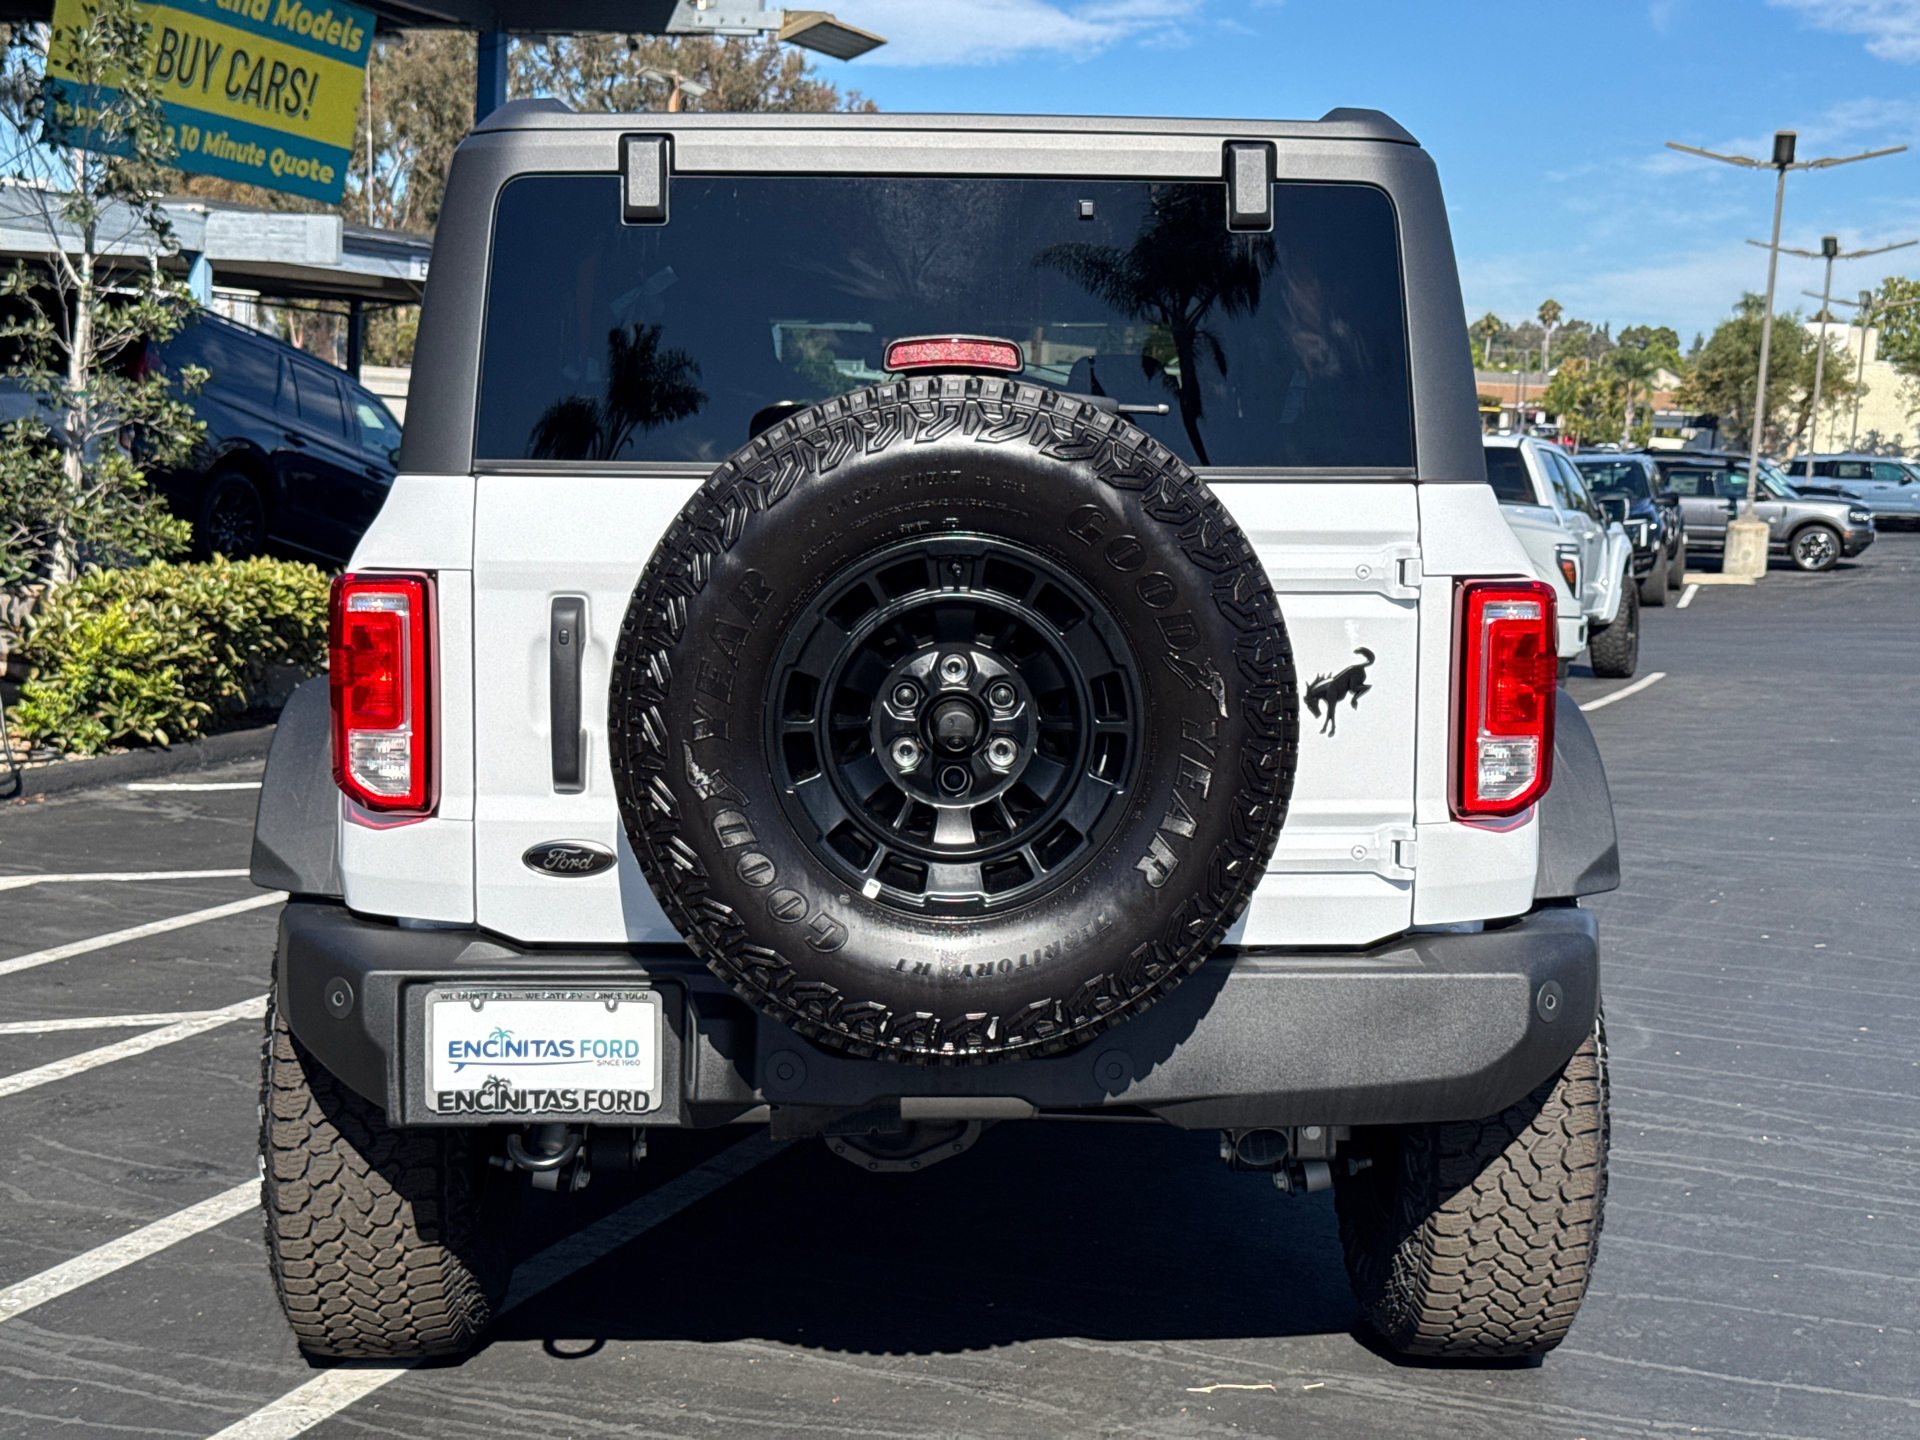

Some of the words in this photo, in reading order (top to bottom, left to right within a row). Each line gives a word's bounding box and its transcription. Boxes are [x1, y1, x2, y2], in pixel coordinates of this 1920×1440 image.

[272, 0, 365, 53] Models
[155, 26, 223, 94] BUY
[225, 49, 321, 121] CARS!
[180, 124, 200, 151] 10
[202, 129, 267, 168] Minute
[269, 147, 335, 185] Quote
[543, 847, 595, 871] Ford
[957, 912, 1113, 980] TERRITORY
[890, 958, 933, 977] RT
[448, 1038, 575, 1058] ENCINITAS
[580, 1039, 640, 1058] FORD
[596, 1059, 621, 1067] SINCE
[621, 1059, 641, 1067] 1960
[437, 1089, 579, 1111] ENCINITAS
[583, 1089, 650, 1111] FORD
